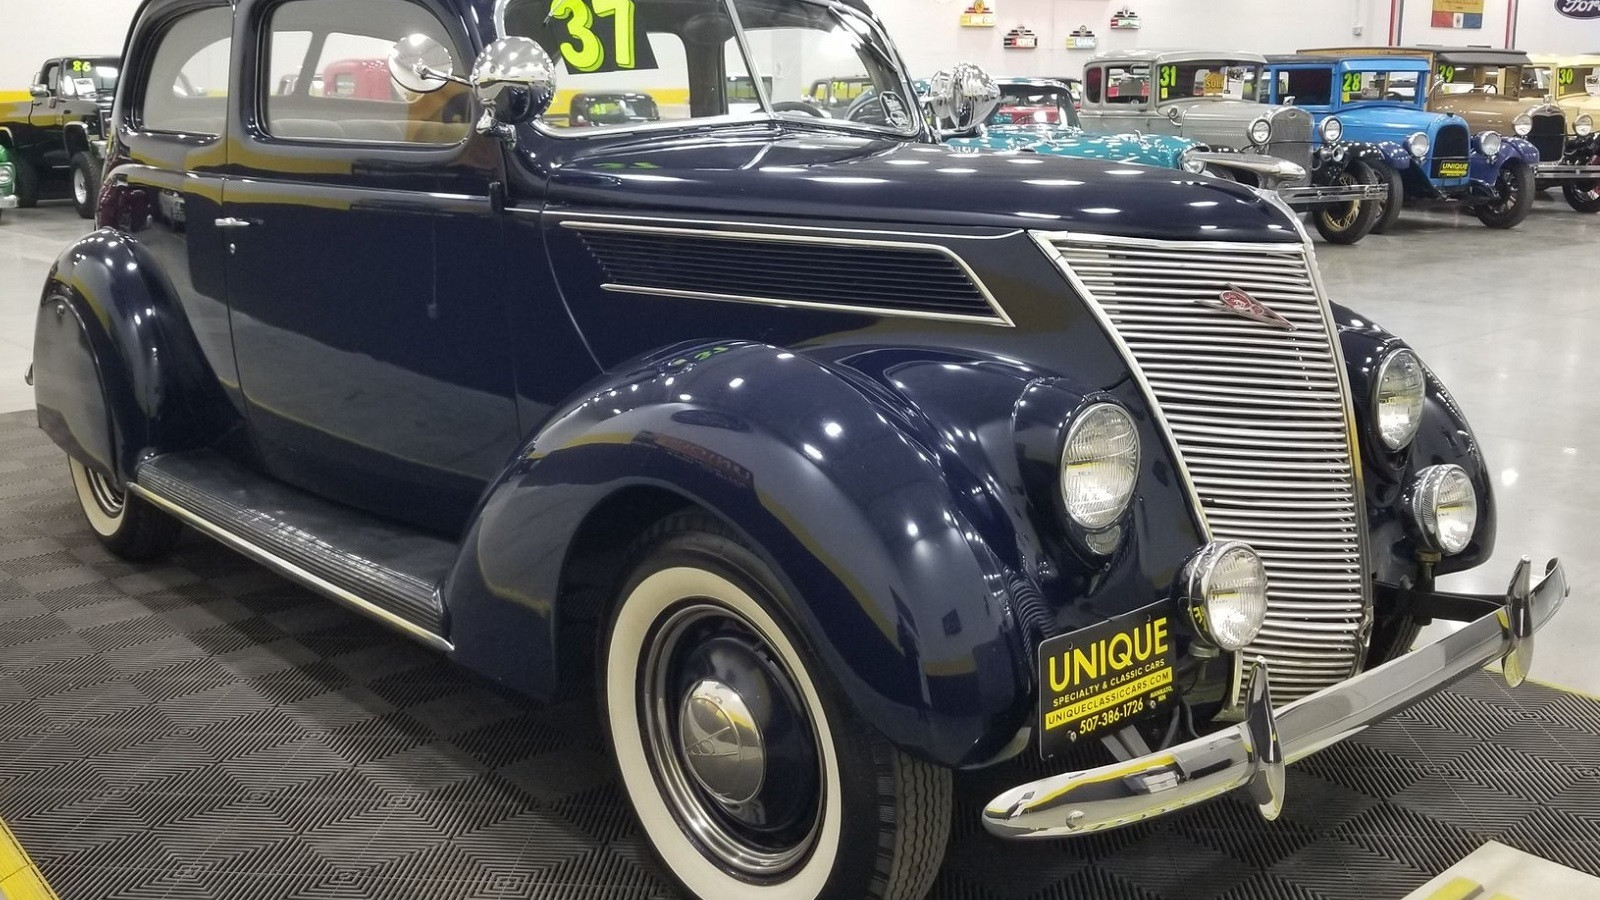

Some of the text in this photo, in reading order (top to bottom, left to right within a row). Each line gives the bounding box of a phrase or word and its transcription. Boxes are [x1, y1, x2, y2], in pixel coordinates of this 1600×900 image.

[1562, 0, 1600, 12] For
[549, 0, 635, 72] 37
[72, 60, 91, 72] 86
[1160, 65, 1177, 87] 31
[1439, 65, 1454, 82] 29
[1559, 68, 1573, 84] 30
[1342, 73, 1361, 91] 28
[1442, 162, 1468, 170] UNIQUE
[1049, 616, 1168, 692] UNIQUE
[1052, 658, 1165, 707] SPECIALTY & CLASSIC CARS
[1048, 671, 1169, 725] UNIQUECLASSICCARS.COM
[1079, 696, 1144, 735] 507-386-1726
